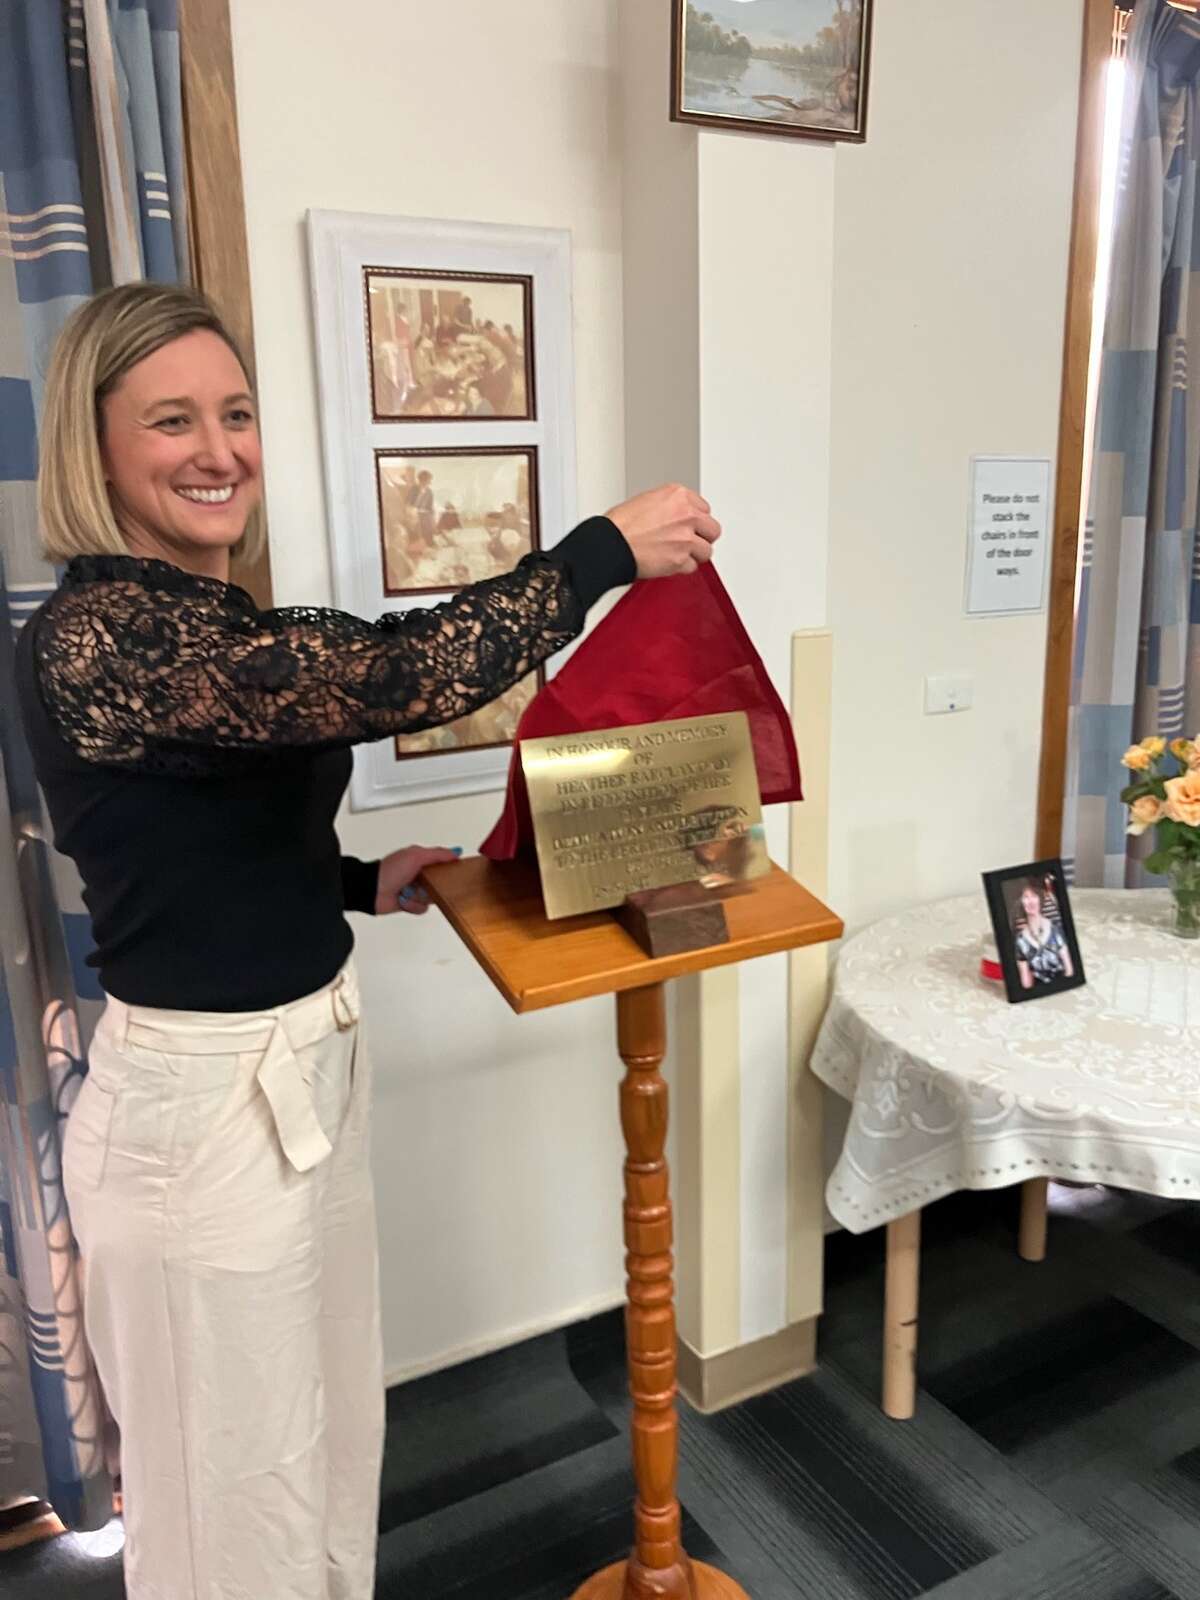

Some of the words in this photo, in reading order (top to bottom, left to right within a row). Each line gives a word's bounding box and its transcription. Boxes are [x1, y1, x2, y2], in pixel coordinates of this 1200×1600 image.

[982, 493, 1010, 503] Please
[1012, 494, 1023, 503] do
[1025, 494, 1040, 503] not
[992, 512, 1013, 522] stack
[1015, 512, 1030, 521] the
[981, 531, 1006, 541] chairs
[1008, 531, 1017, 540] in
[1018, 529, 1039, 540] front
[986, 548, 996, 558] of
[997, 548, 1011, 558] the
[1013, 548, 1032, 558] door
[636, 732, 665, 747] AND
[633, 752, 654, 765] OF
[556, 774, 626, 795] HEATHER
